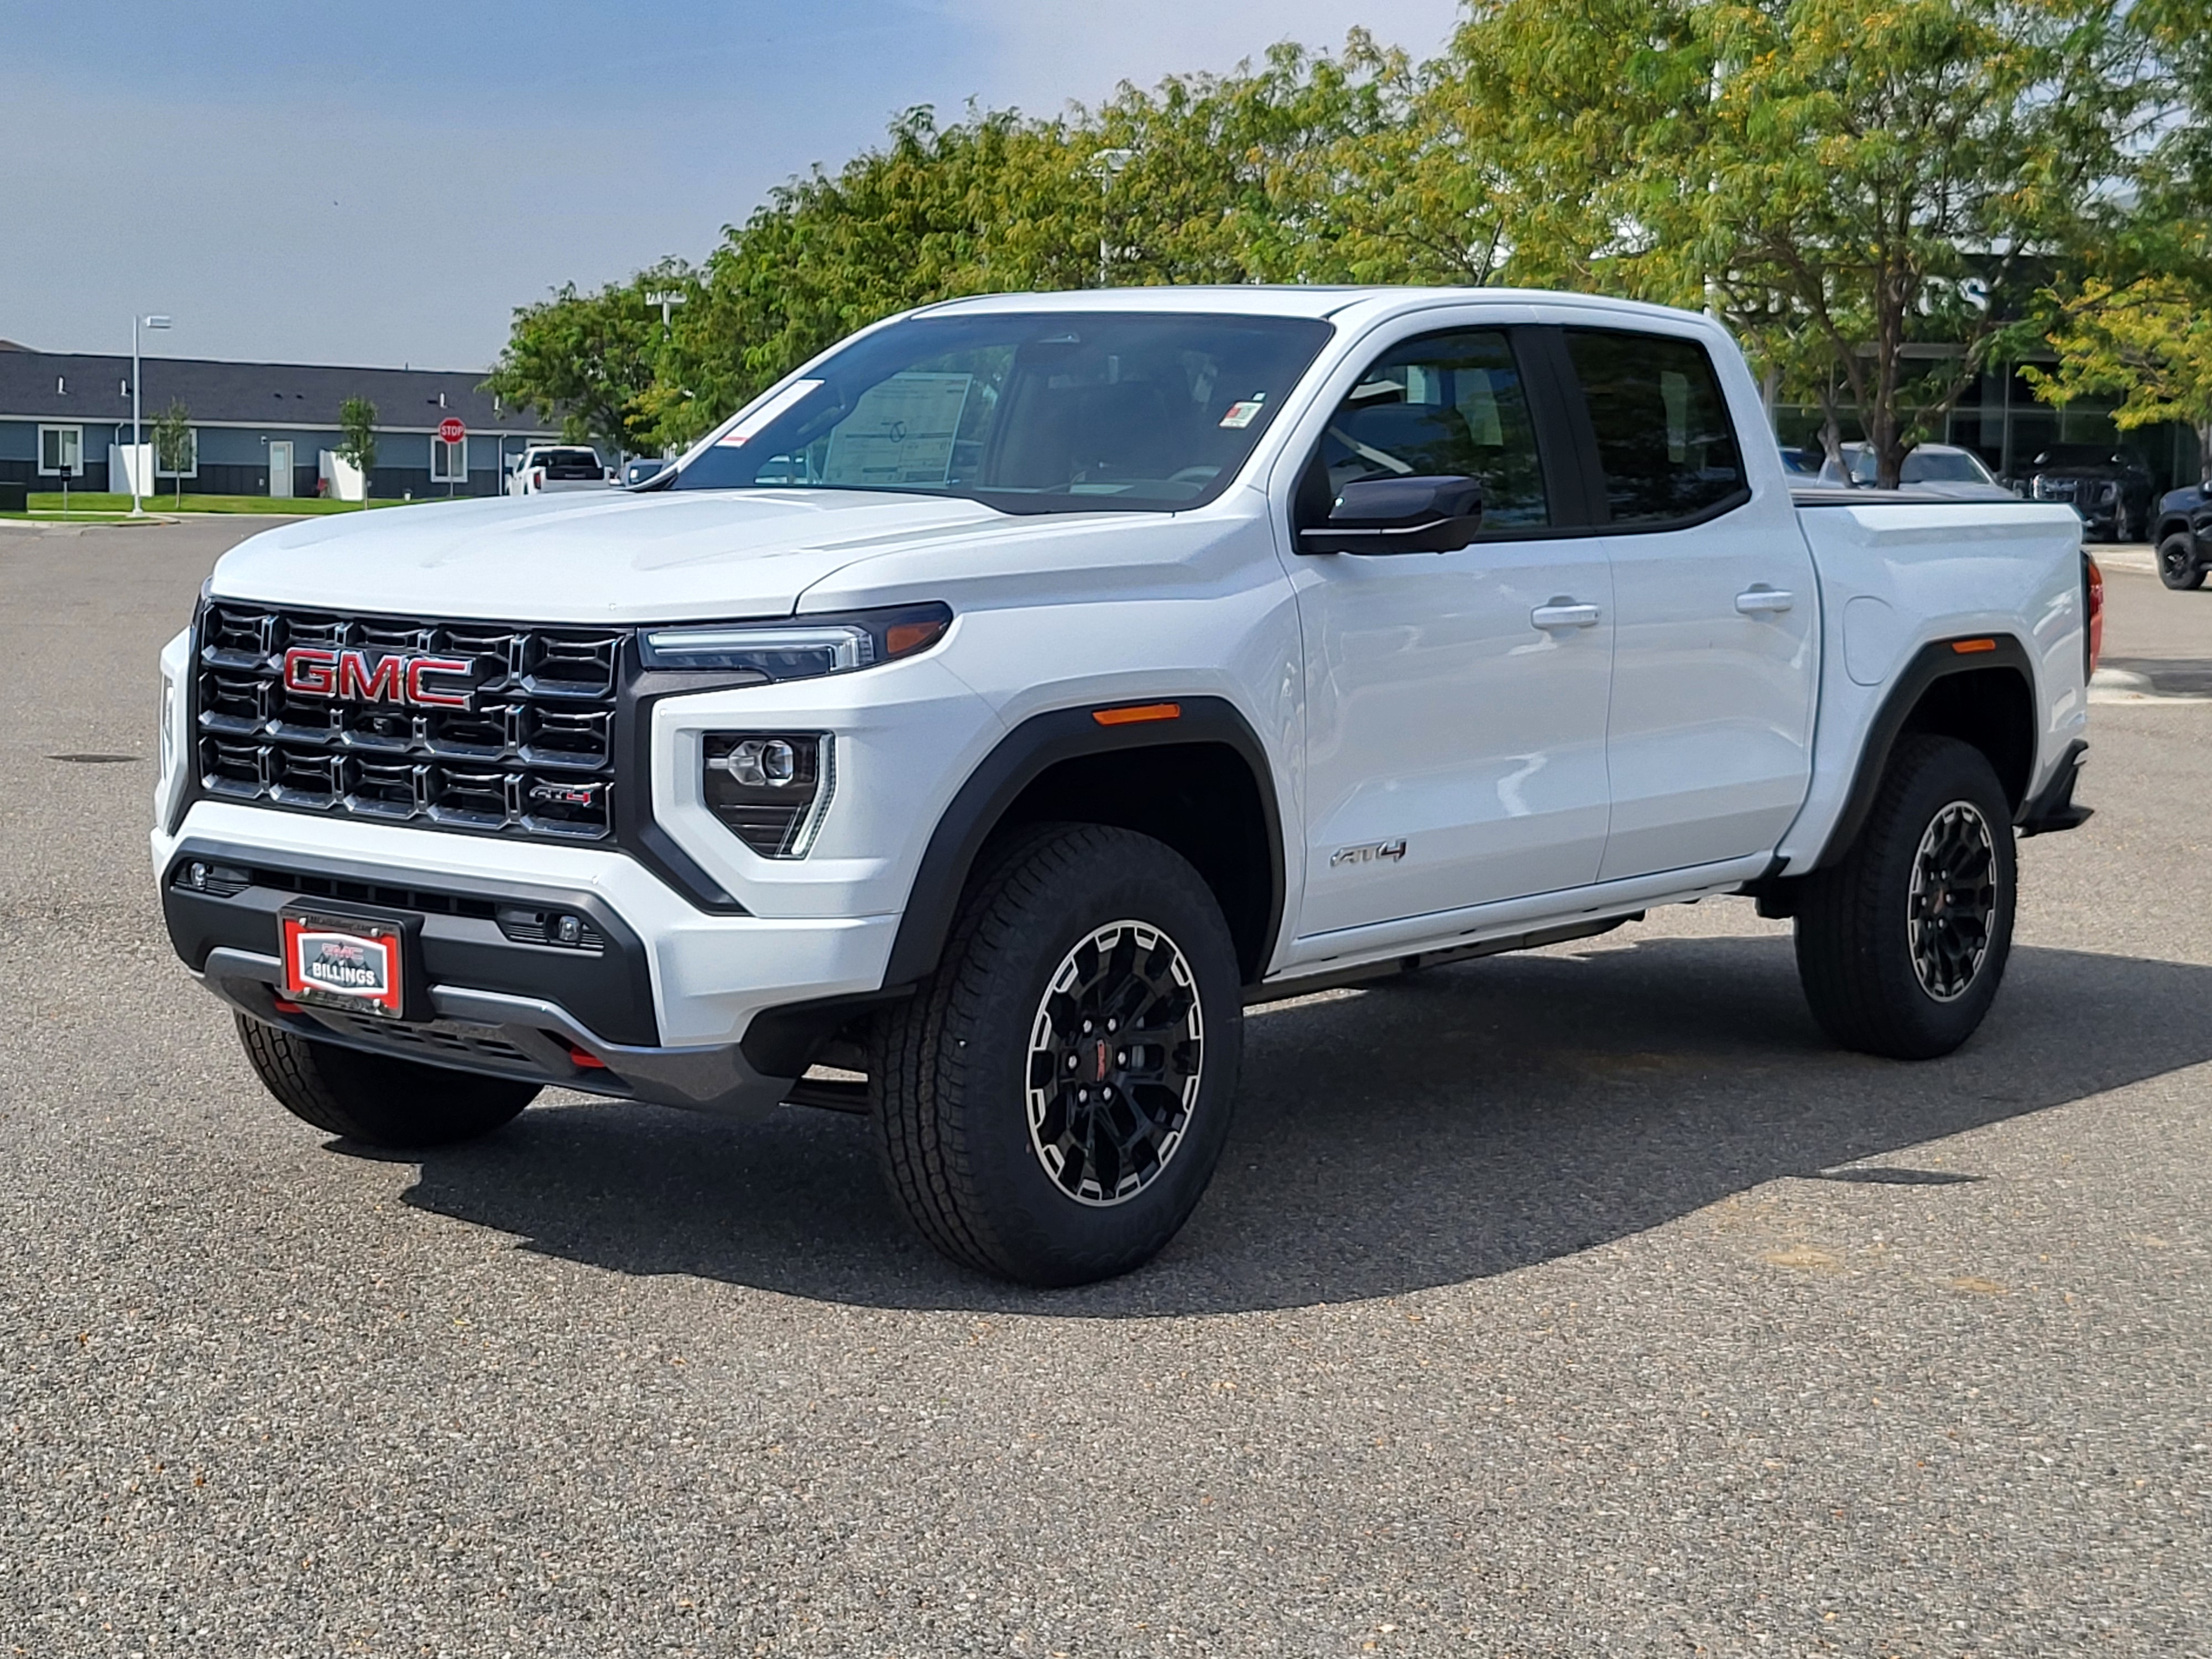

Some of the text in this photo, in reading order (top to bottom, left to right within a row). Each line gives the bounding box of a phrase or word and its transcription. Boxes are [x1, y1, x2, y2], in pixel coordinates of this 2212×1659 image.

[441, 425, 464, 436] STOP
[284, 646, 476, 711] GMC
[1331, 837, 1406, 867] AT4
[313, 962, 375, 985] BILLINGS
